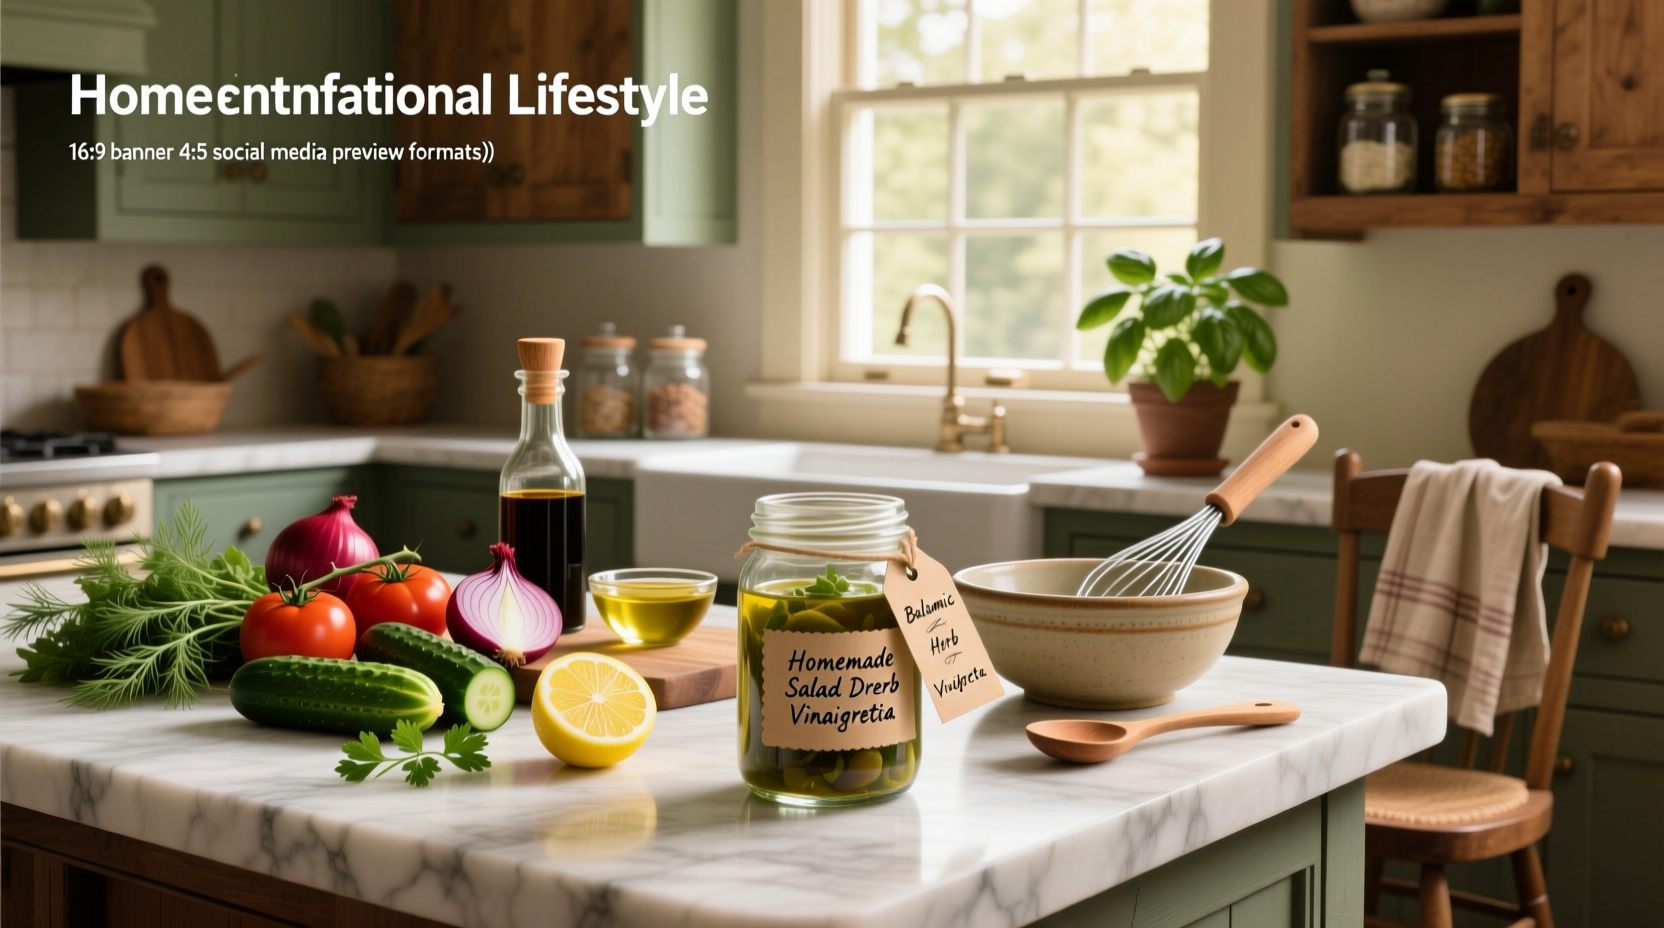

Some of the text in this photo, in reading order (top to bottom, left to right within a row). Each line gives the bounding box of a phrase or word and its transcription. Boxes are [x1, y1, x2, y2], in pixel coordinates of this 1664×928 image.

[930, 627, 959, 656] Herb
[788, 646, 894, 672] Homemade
[784, 672, 900, 698] Salad Drerb
